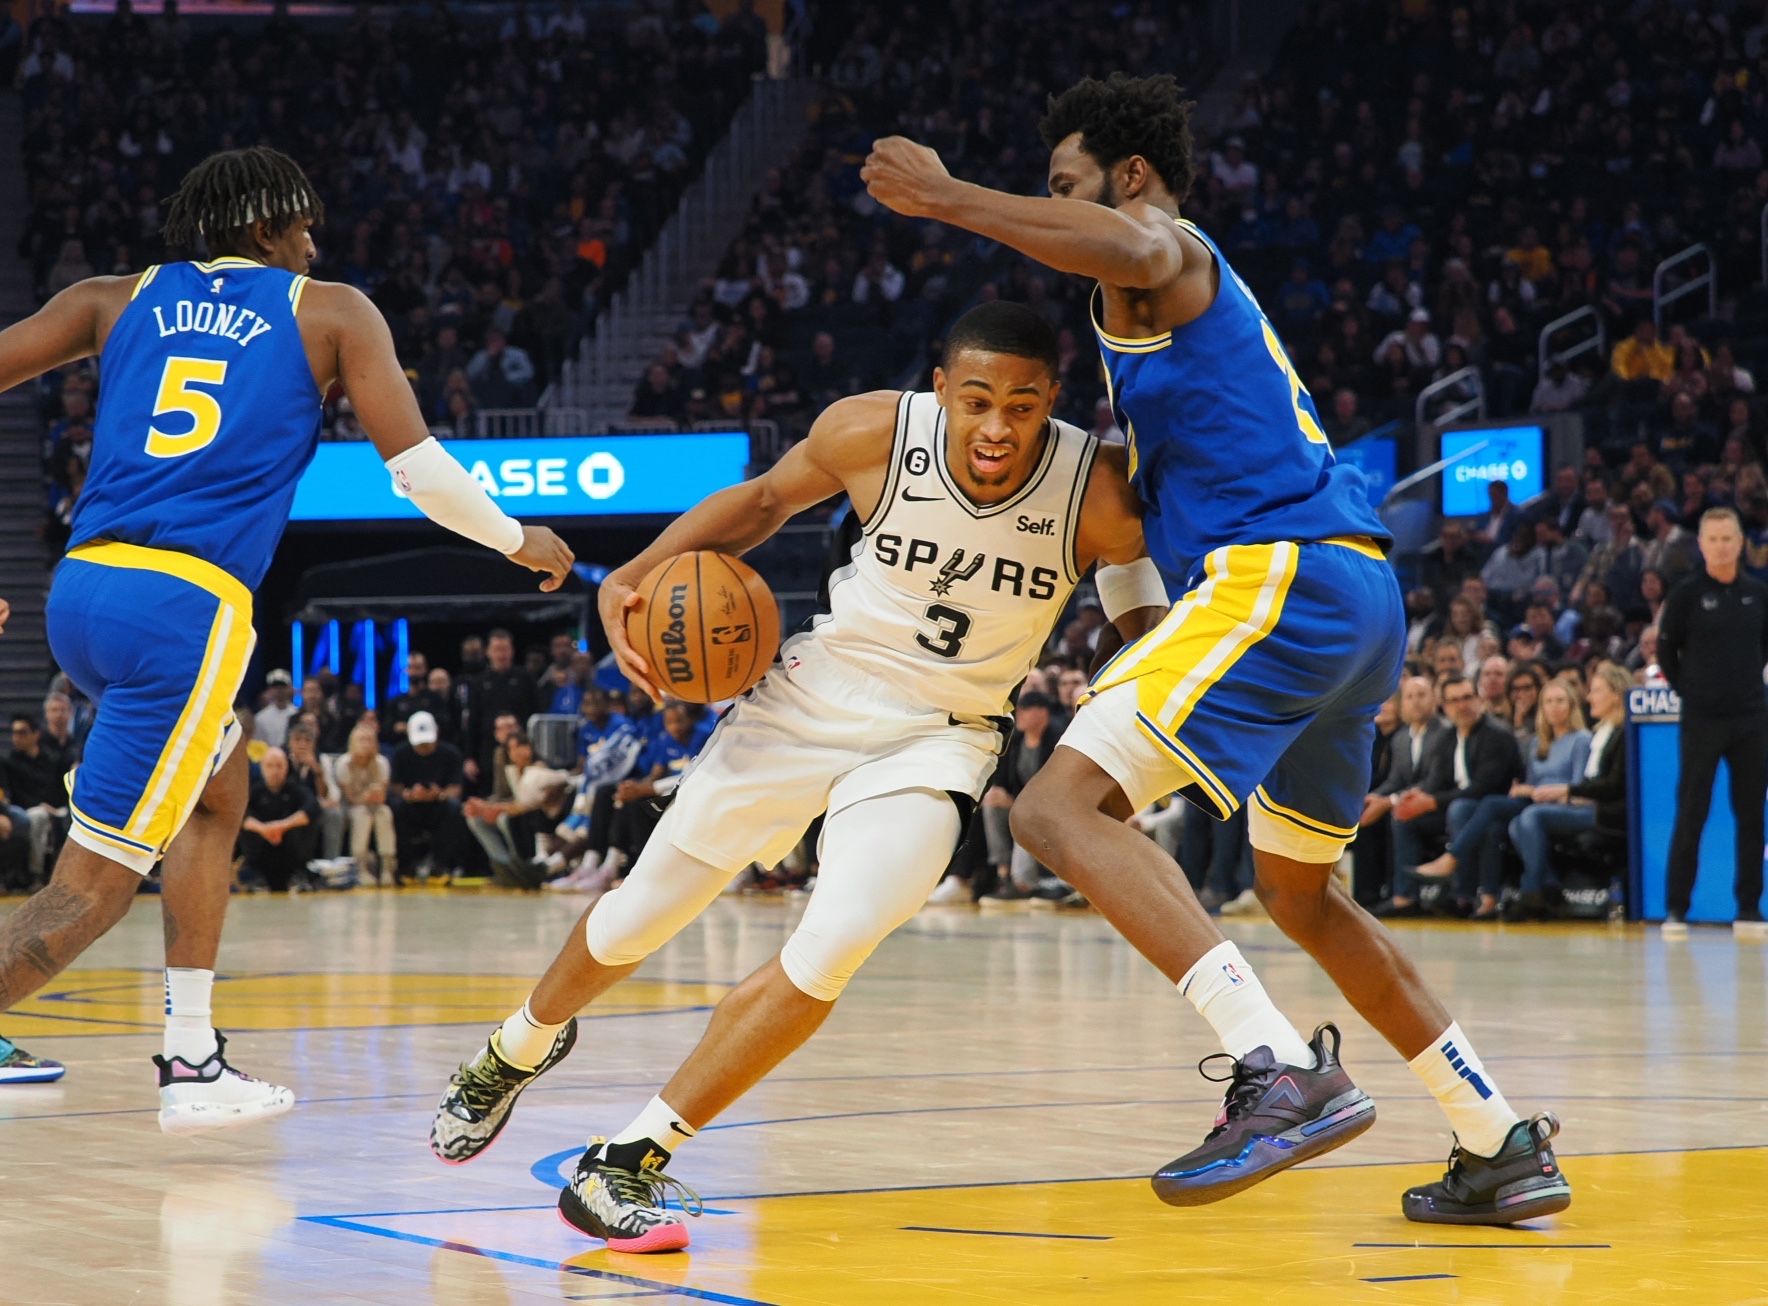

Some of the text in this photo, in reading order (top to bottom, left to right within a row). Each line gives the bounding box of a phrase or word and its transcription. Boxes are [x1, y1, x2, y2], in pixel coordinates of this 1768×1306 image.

[152, 300, 272, 347] LOONEY
[144, 355, 228, 459] 5
[909, 450, 925, 474] 6
[1455, 462, 1509, 482] CHASE
[1016, 515, 1056, 536] Self.
[875, 533, 1058, 600] SPURS
[661, 583, 694, 684] Wilson
[914, 602, 974, 660] 3
[1629, 690, 1682, 714] CHAS
